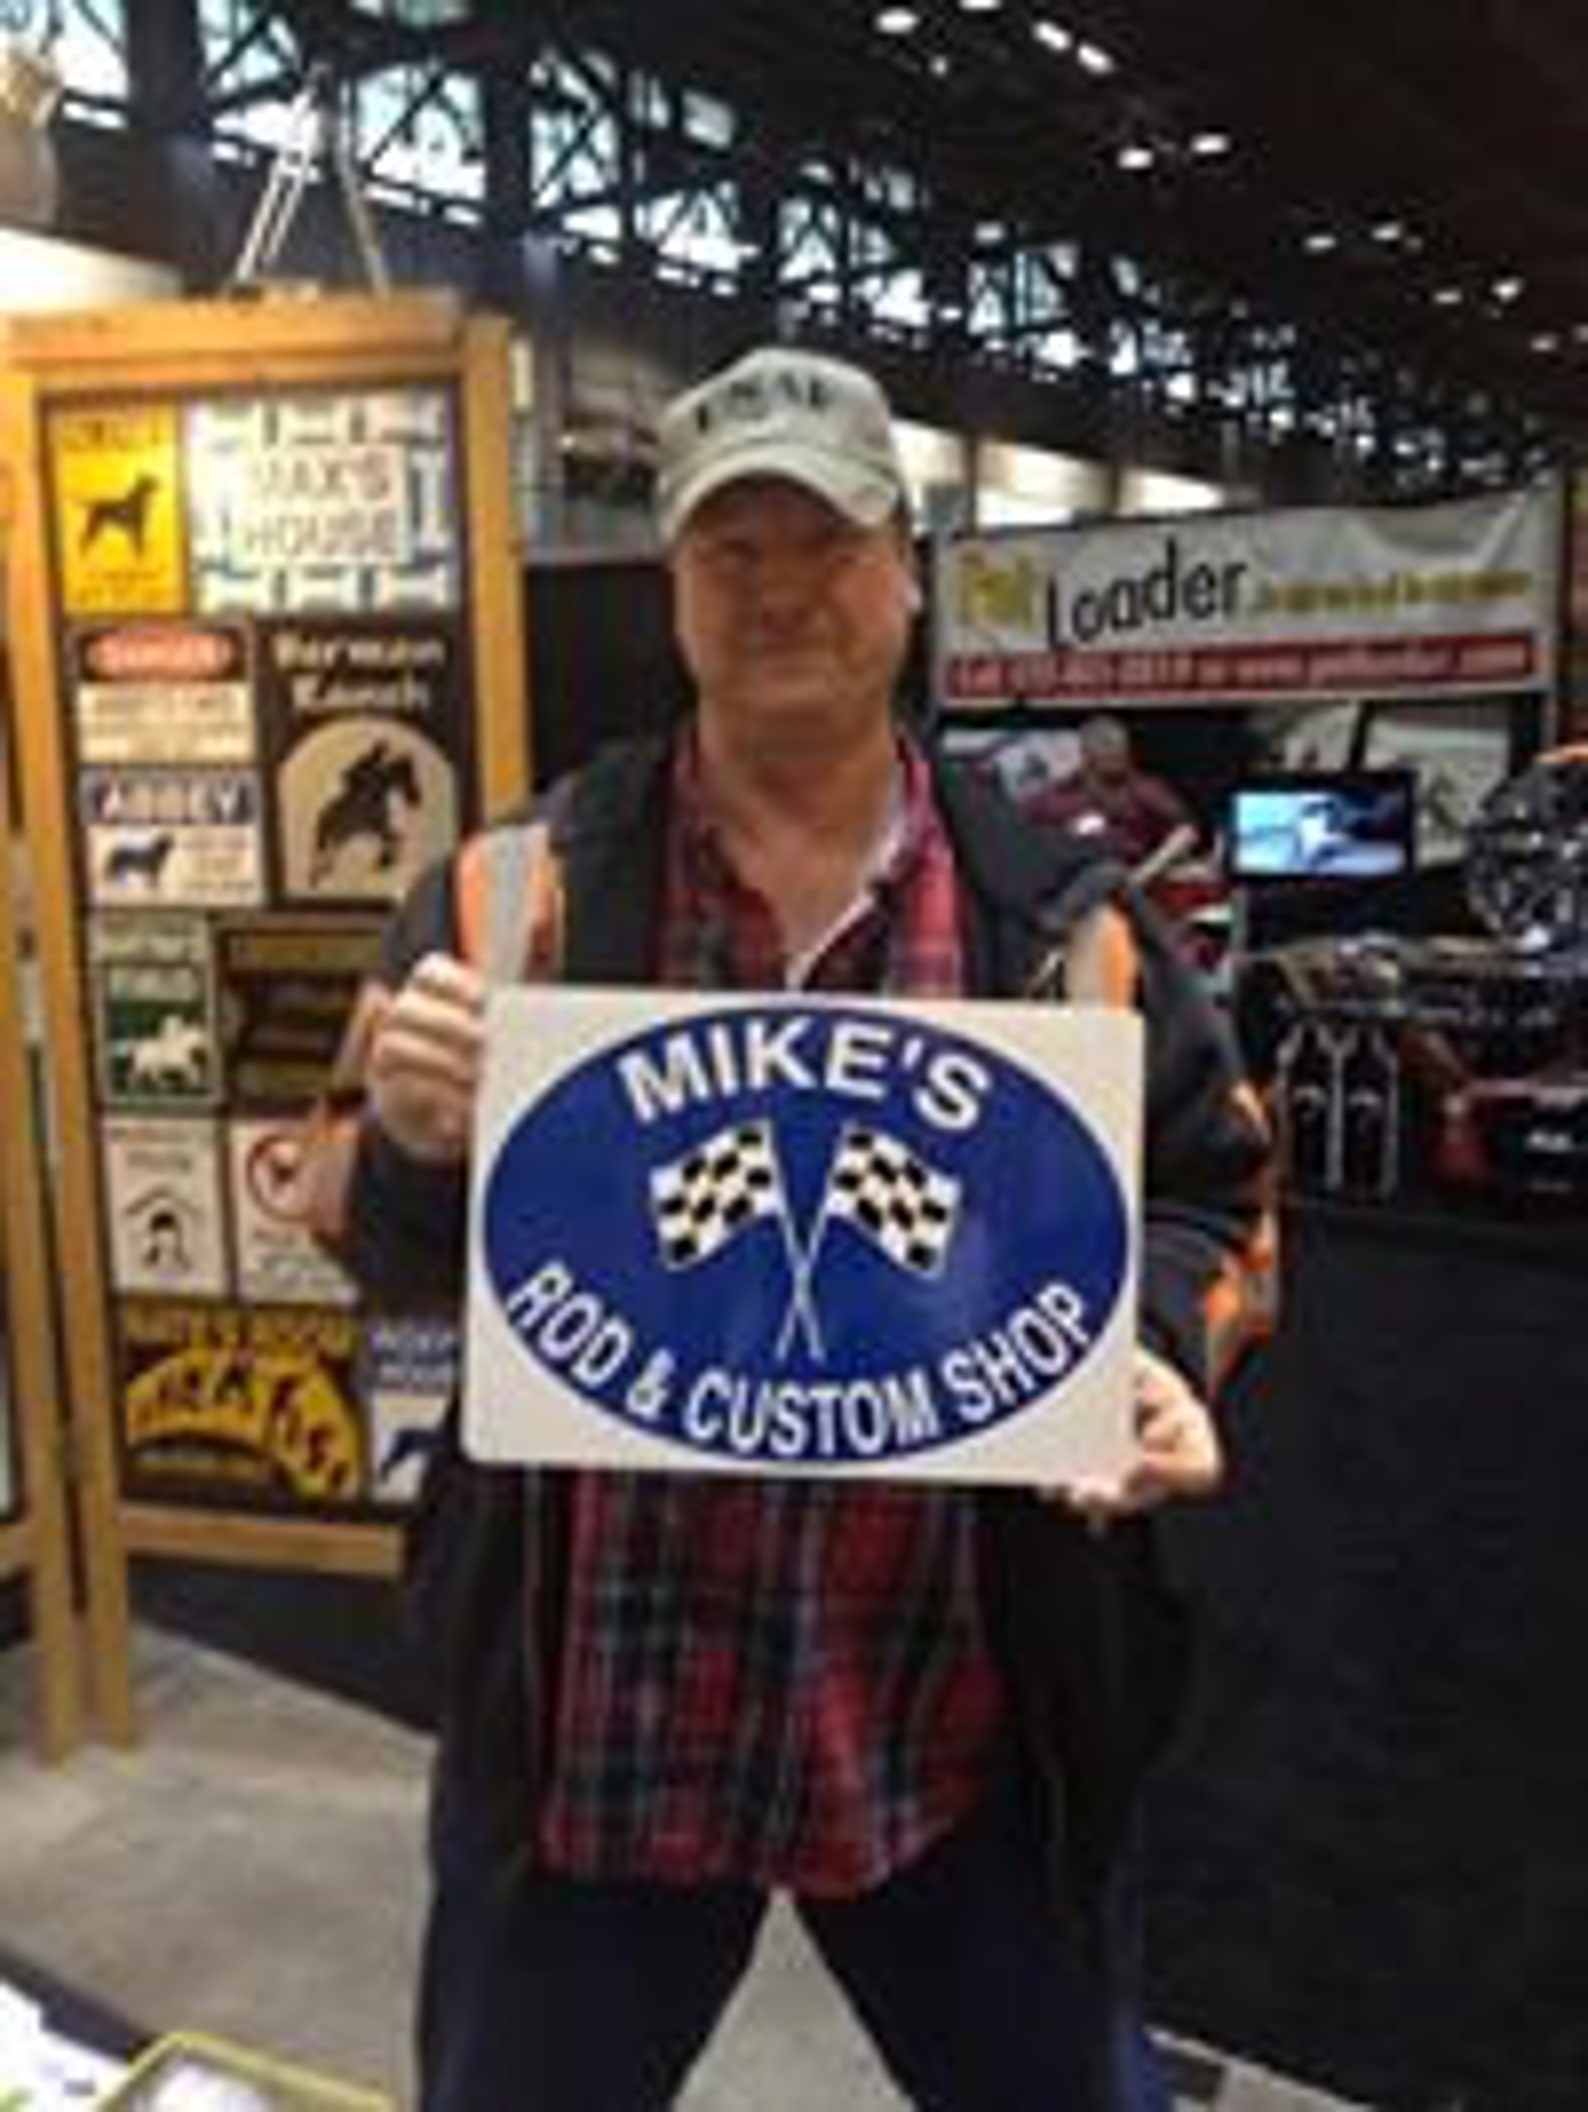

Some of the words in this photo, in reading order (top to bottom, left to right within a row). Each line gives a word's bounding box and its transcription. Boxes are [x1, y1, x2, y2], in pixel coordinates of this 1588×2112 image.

[1045, 534, 1248, 650] Loader
[616, 1016, 990, 1132] MIKE'S
[507, 1259, 631, 1387] ROD
[626, 1348, 676, 1419] &
[682, 1366, 939, 1455] CUSTOM
[941, 1281, 1090, 1422] SHOP
